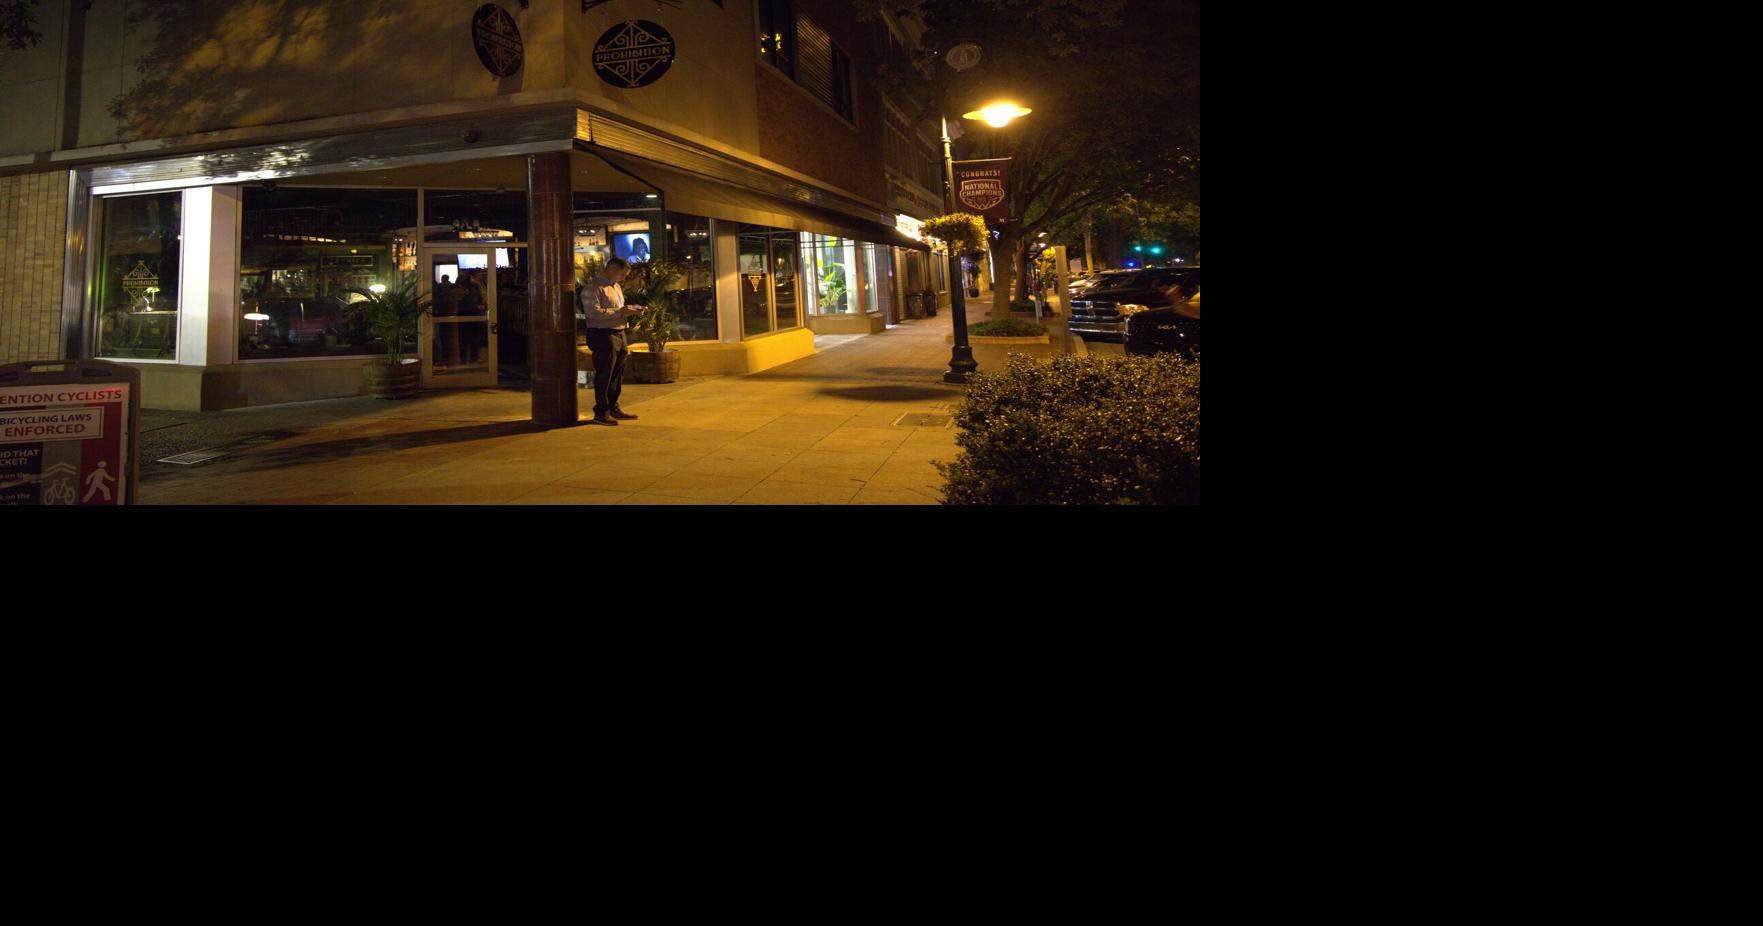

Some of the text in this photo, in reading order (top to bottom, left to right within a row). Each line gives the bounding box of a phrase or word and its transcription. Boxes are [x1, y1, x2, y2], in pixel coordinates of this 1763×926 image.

[596, 45, 671, 62] PROHIBITION
[961, 170, 1000, 178] CONGRATS!
[964, 182, 998, 191] NATIONAL
[962, 189, 1003, 198] CHAMPIONS
[57, 390, 122, 401] CYCLISTS
[0, 414, 92, 425] BICYCLING LAWS
[5, 424, 85, 436] ENFORCED
[13, 449, 40, 457] THAT
